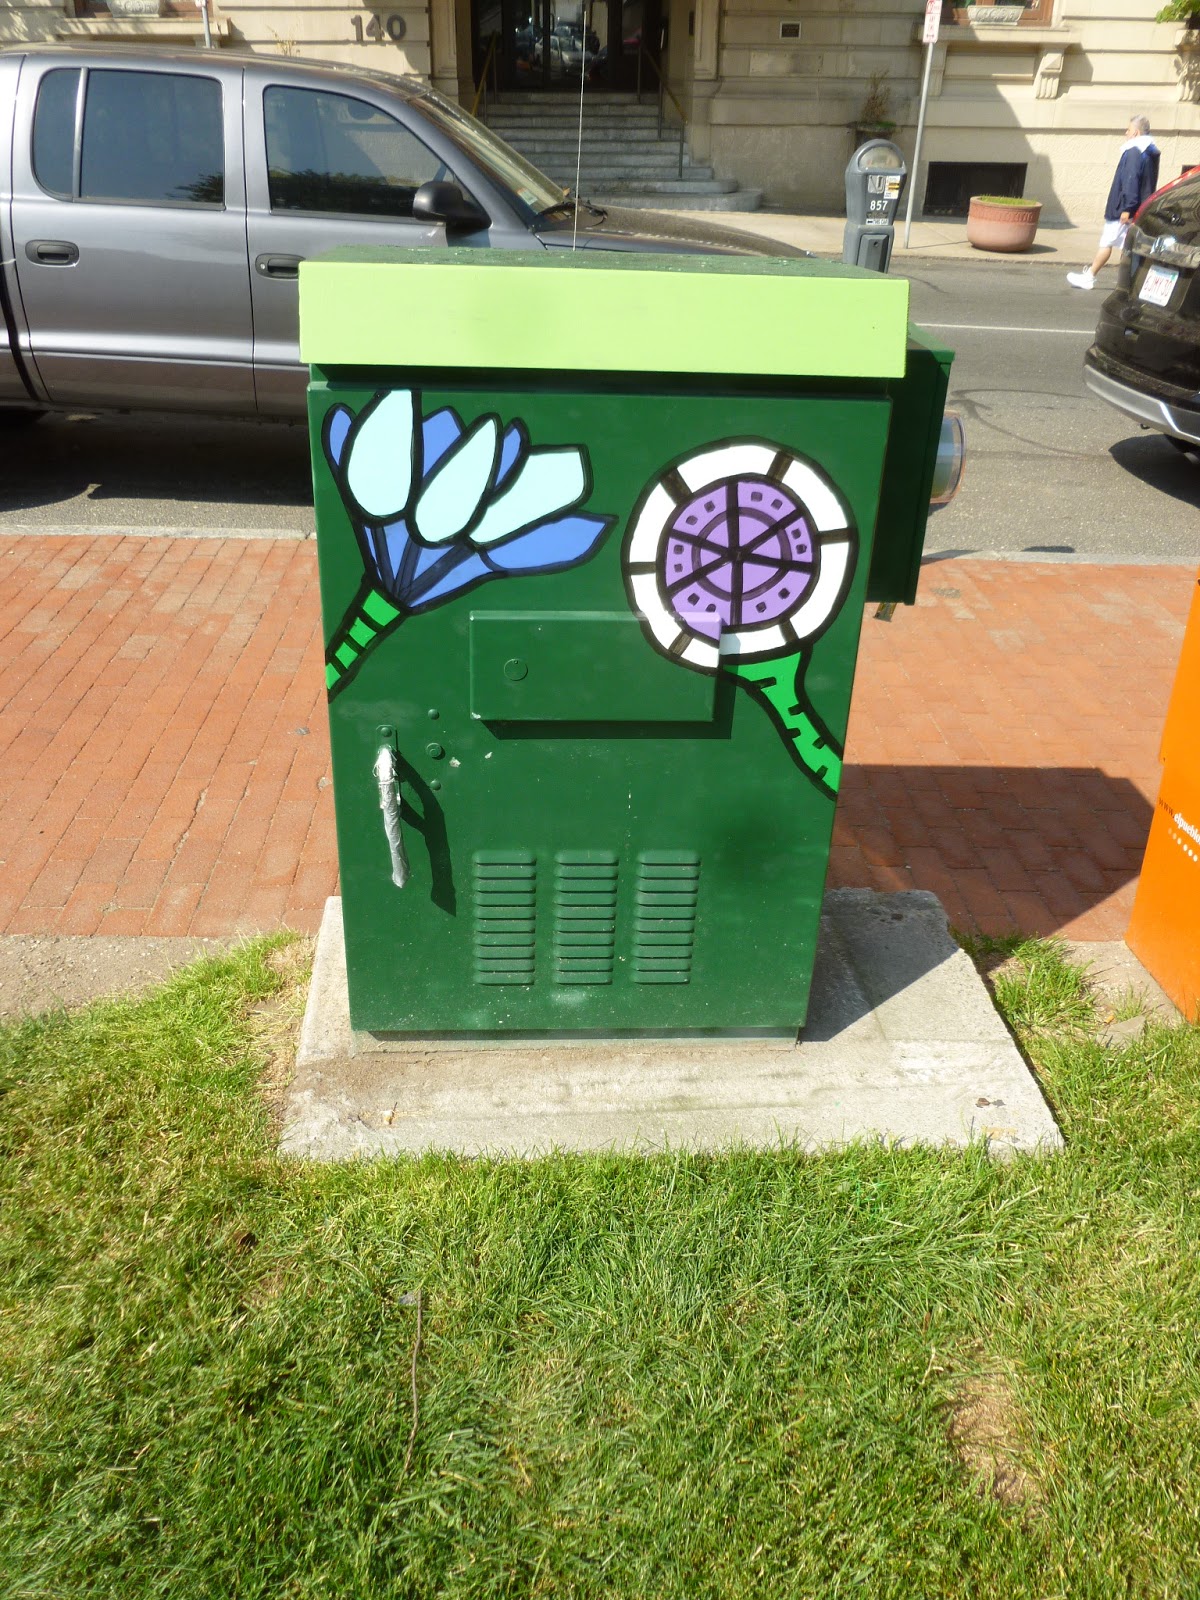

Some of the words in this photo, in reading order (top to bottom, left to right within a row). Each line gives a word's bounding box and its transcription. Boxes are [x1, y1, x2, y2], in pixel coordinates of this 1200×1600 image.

[350, 14, 406, 43] 140
[870, 200, 888, 211] 857
[1158, 797, 1200, 845] www.elpueblo
